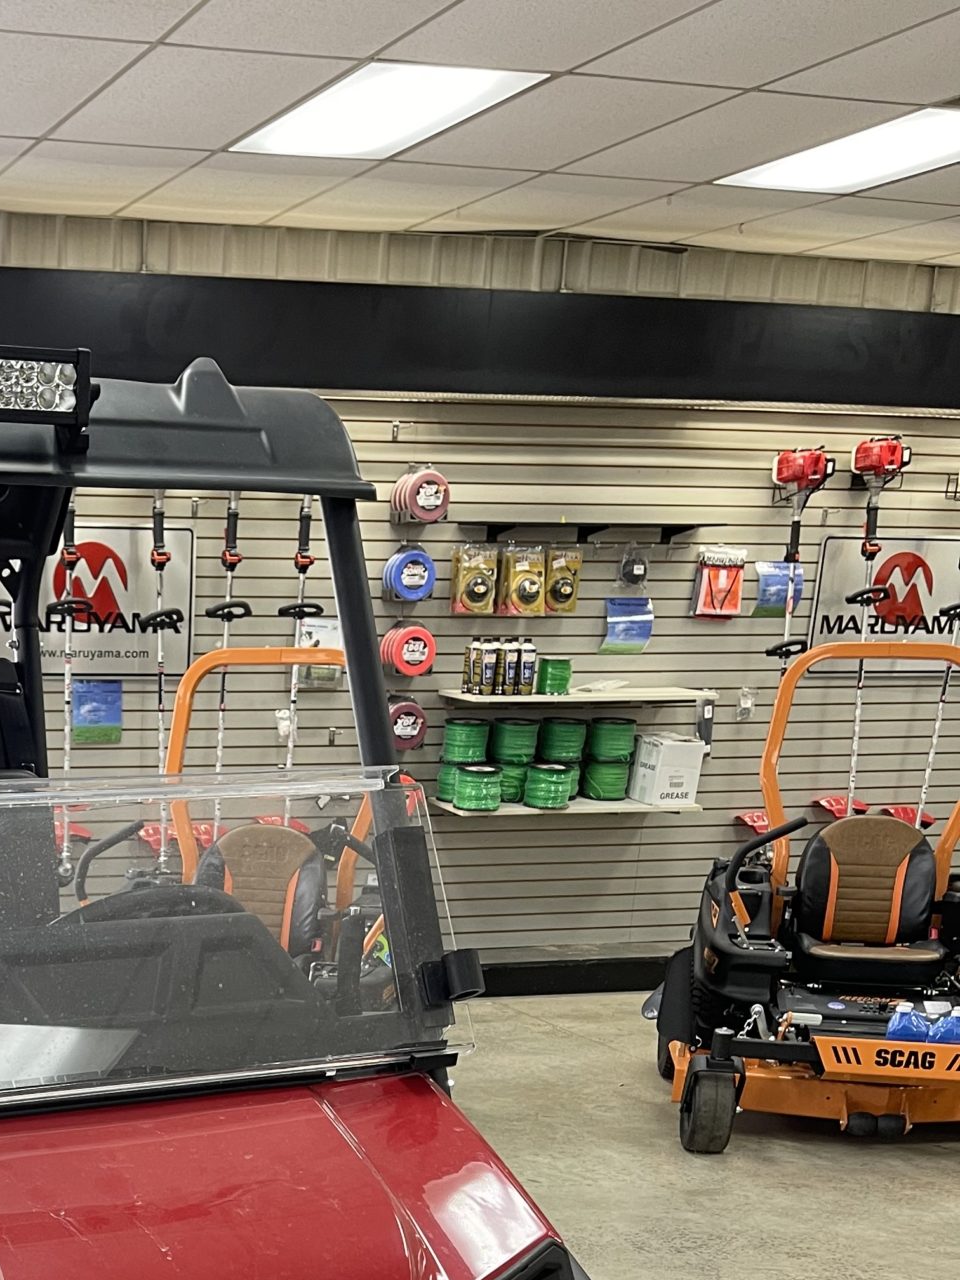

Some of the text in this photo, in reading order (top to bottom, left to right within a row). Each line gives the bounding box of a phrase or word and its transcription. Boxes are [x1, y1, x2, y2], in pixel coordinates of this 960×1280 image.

[820, 614, 959, 635] MARUYAM
[40, 649, 150, 662] ww.maruyama.com
[660, 791, 690, 800] GREASE
[874, 1048, 936, 1070] SCAG
